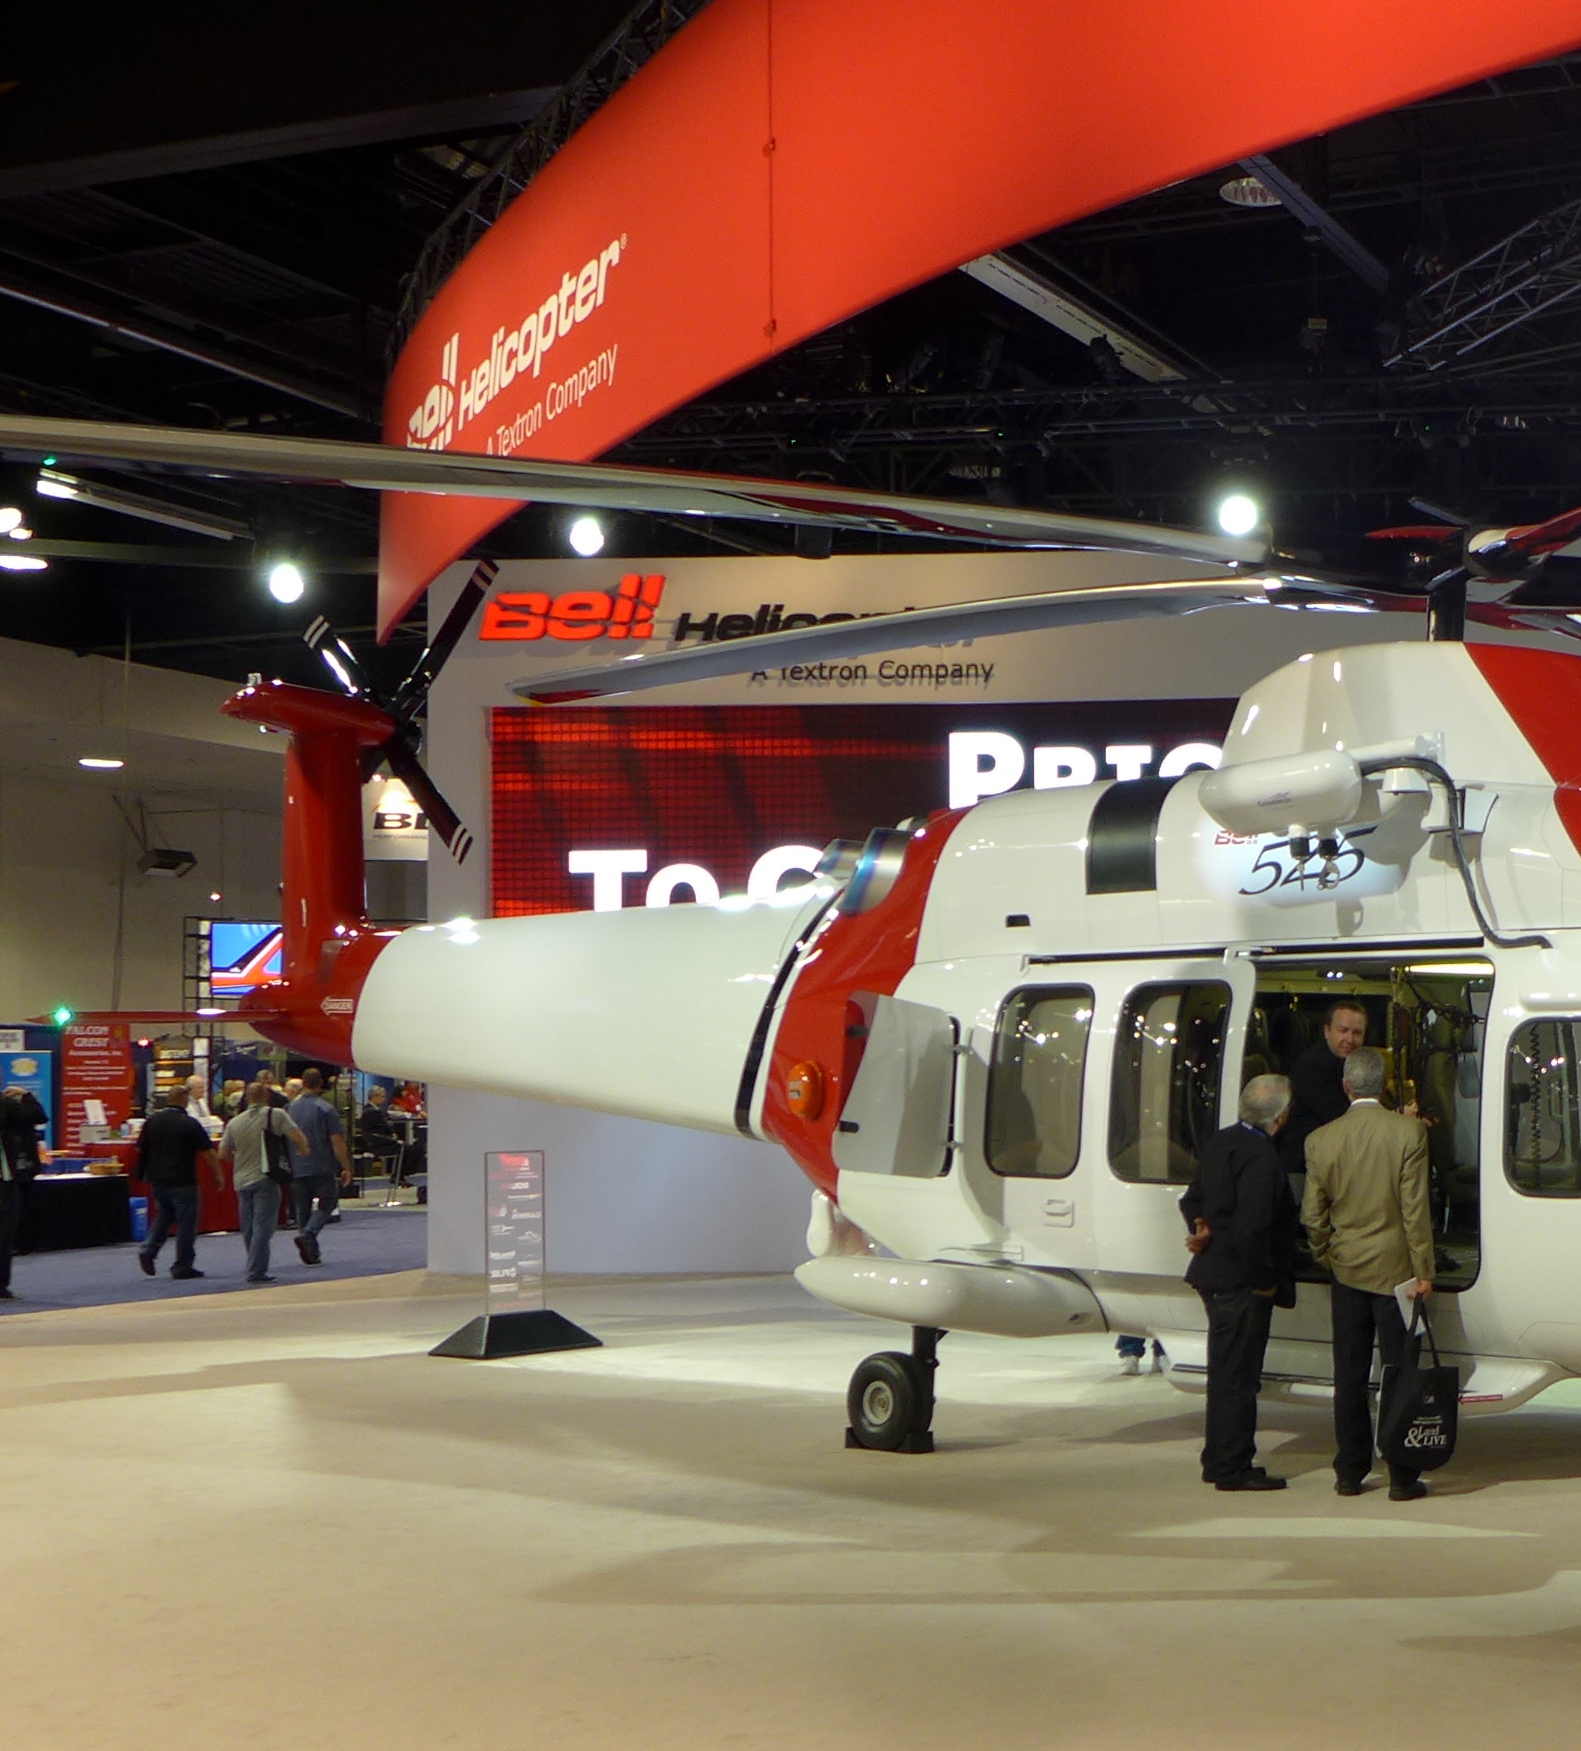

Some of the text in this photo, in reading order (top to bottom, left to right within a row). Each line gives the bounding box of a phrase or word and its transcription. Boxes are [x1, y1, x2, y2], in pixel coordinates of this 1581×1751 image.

[497, 401, 542, 456] Textron
[546, 343, 618, 420] Company
[478, 574, 666, 641] Bell
[780, 662, 867, 681] Textron
[878, 660, 995, 683] Company
